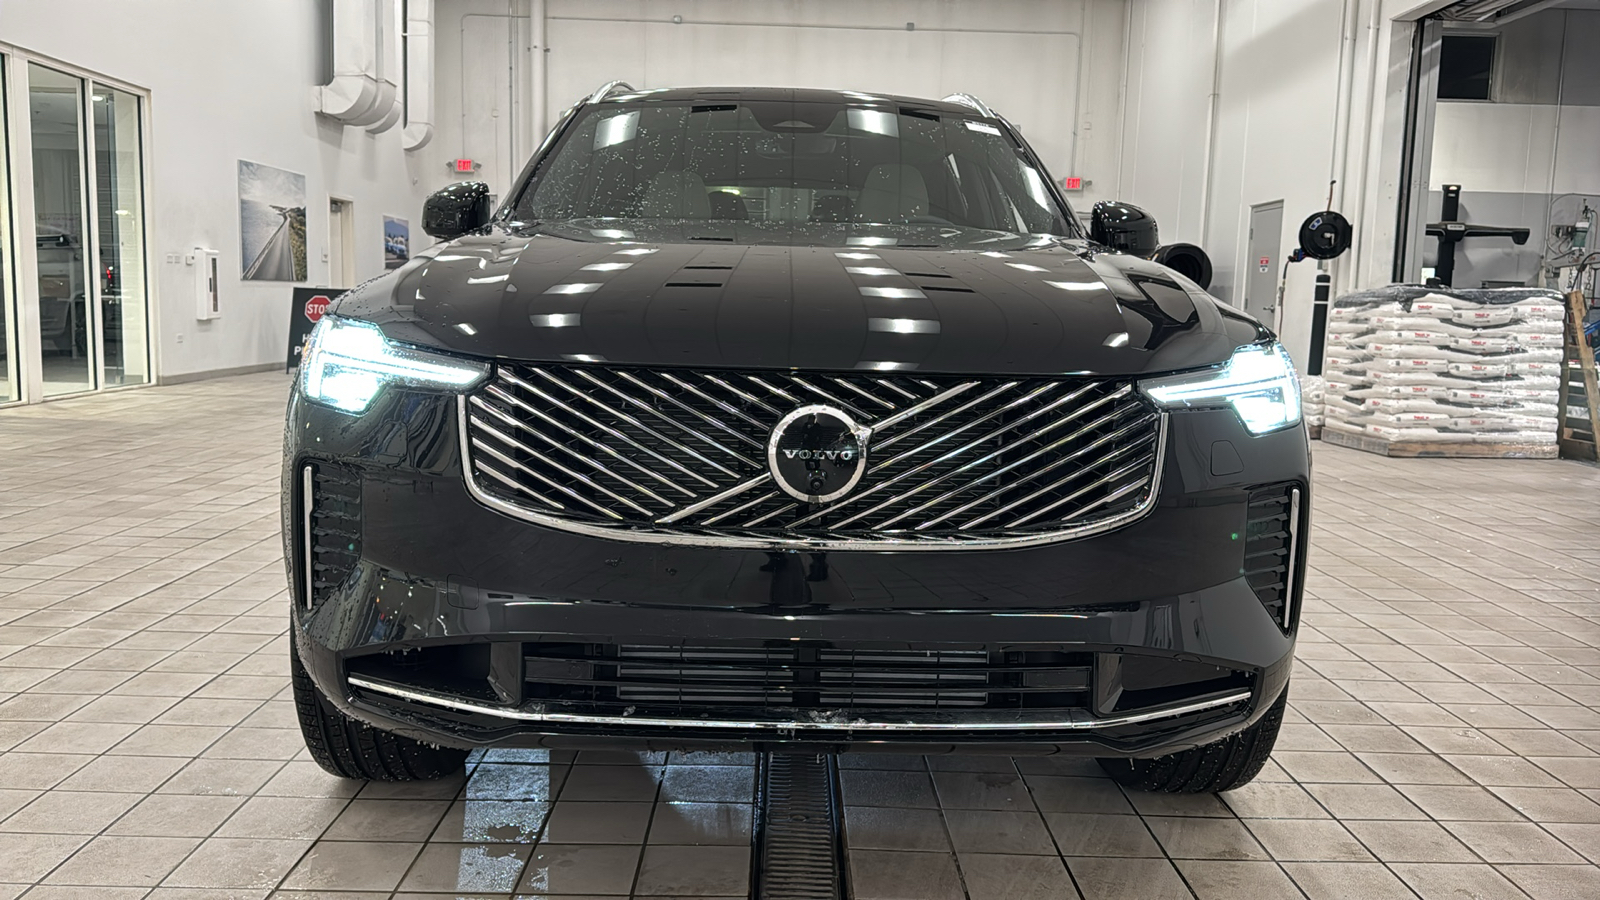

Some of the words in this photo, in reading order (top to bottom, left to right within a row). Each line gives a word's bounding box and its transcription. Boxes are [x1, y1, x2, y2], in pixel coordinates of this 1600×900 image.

[457, 159, 472, 171] EXIT
[1066, 177, 1081, 189] EXIT
[307, 304, 329, 315] STO
[782, 449, 853, 461] VOLVO
